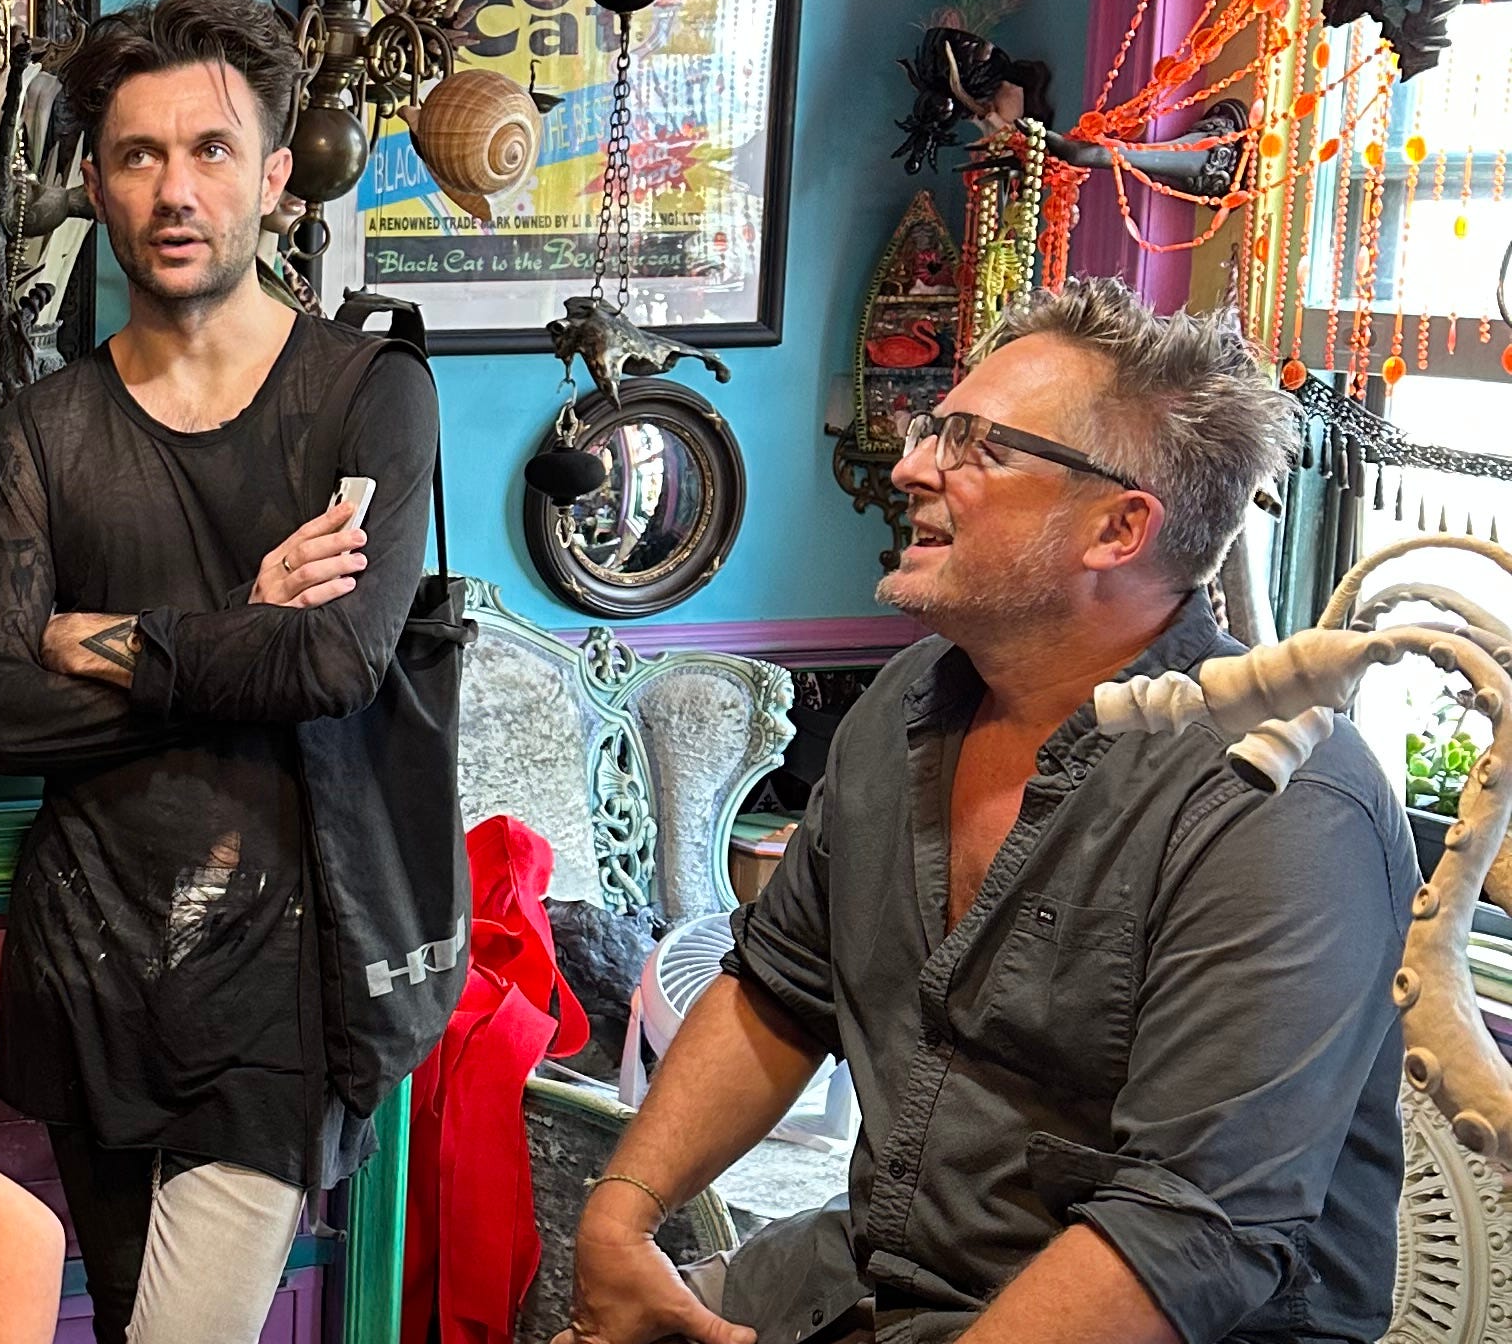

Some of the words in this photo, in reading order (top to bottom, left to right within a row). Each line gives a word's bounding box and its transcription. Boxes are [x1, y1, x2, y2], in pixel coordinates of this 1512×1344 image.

[369, 218, 377, 231] A
[379, 216, 440, 231] RENOWNED
[443, 216, 477, 230] TRADE
[481, 216, 510, 229] ARK
[514, 215, 552, 229] OWNED
[555, 215, 569, 228] BY
[443, 249, 484, 273] Cat
[491, 255, 509, 271] is
[514, 253, 543, 271] the
